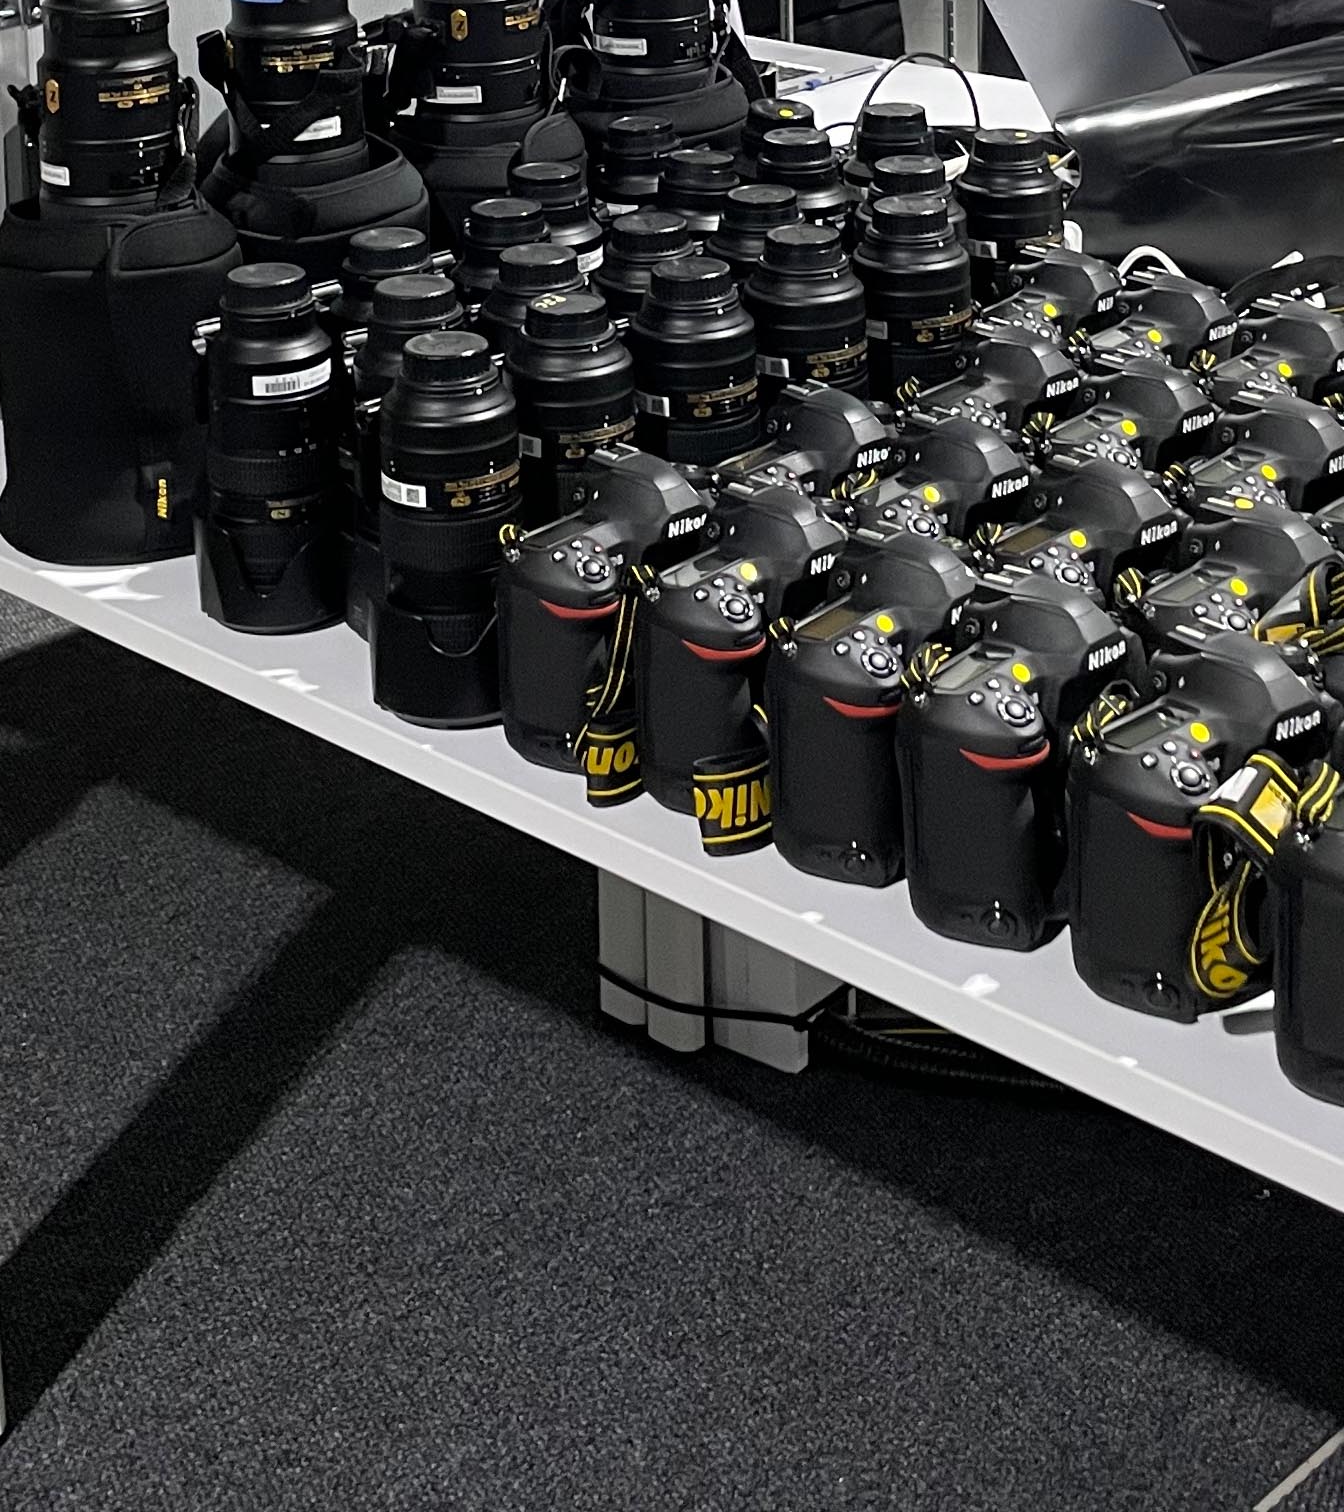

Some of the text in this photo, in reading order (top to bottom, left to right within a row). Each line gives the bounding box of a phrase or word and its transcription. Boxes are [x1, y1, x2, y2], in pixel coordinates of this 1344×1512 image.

[1046, 377, 1079, 398] Nikon
[1182, 411, 1215, 434] Nikon
[857, 447, 891, 467] Niko
[156, 478, 169, 519] Nikon
[991, 475, 1029, 499] Nikon
[1140, 520, 1177, 545] Nikon
[1088, 640, 1126, 671] Nikon
[1275, 709, 1320, 741] Nikon
